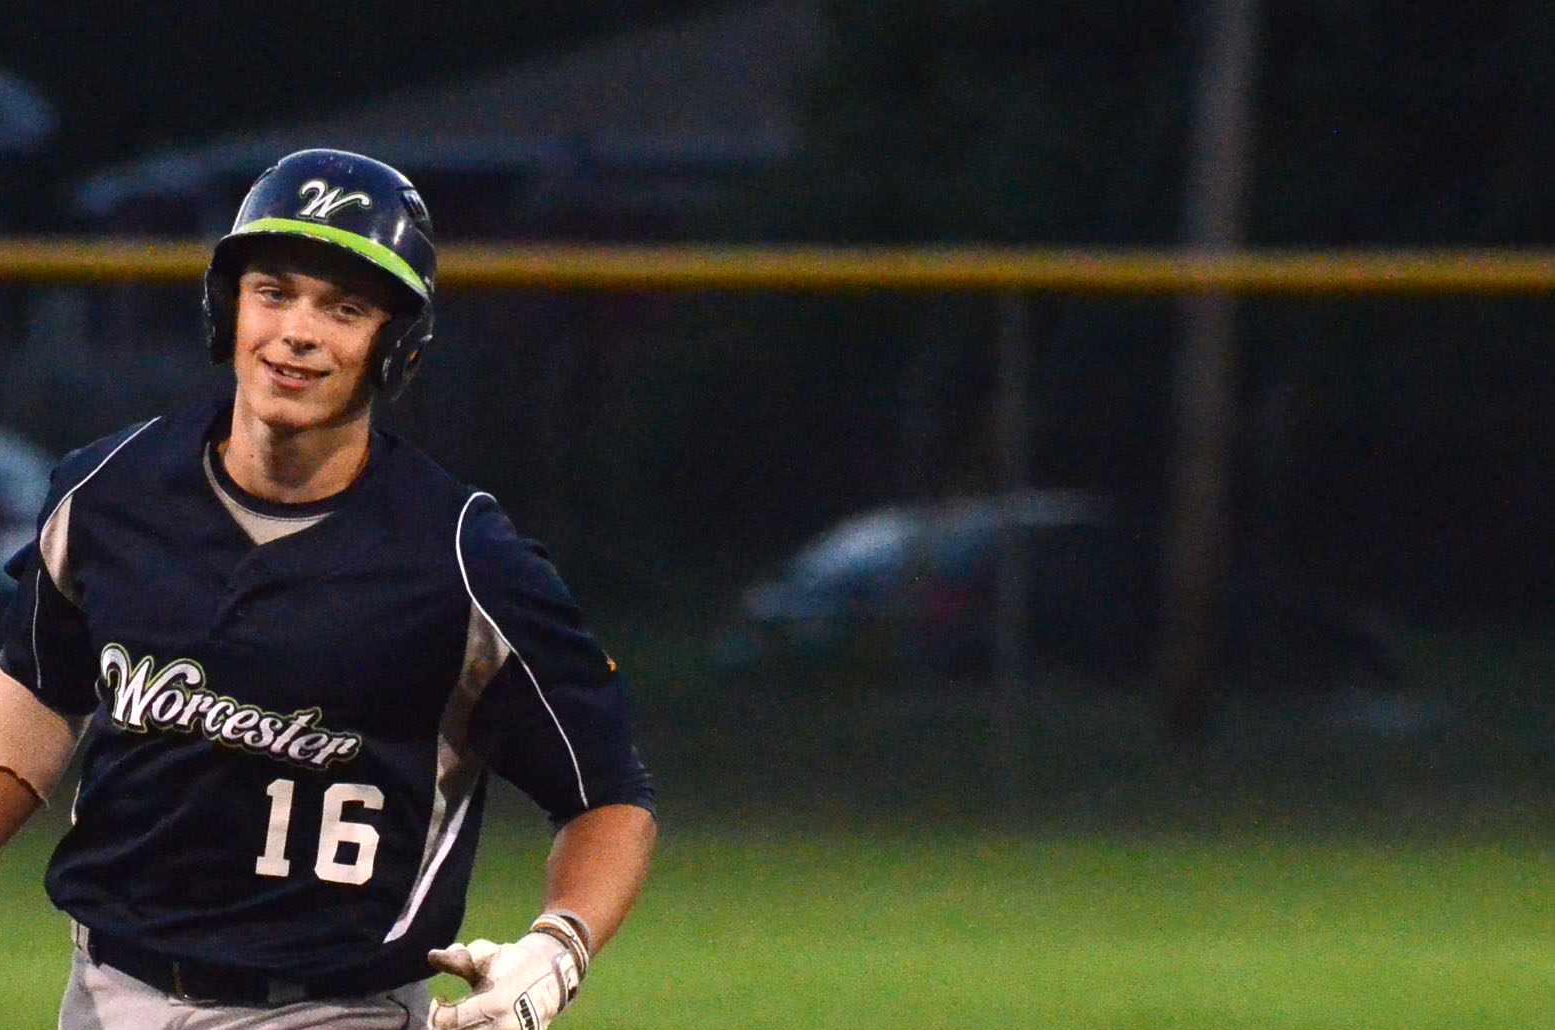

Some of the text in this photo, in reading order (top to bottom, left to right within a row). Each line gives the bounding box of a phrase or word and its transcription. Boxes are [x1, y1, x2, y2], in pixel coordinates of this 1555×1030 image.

[299, 179, 372, 220] W
[100, 643, 362, 769] Worcester
[255, 778, 385, 886] 16
